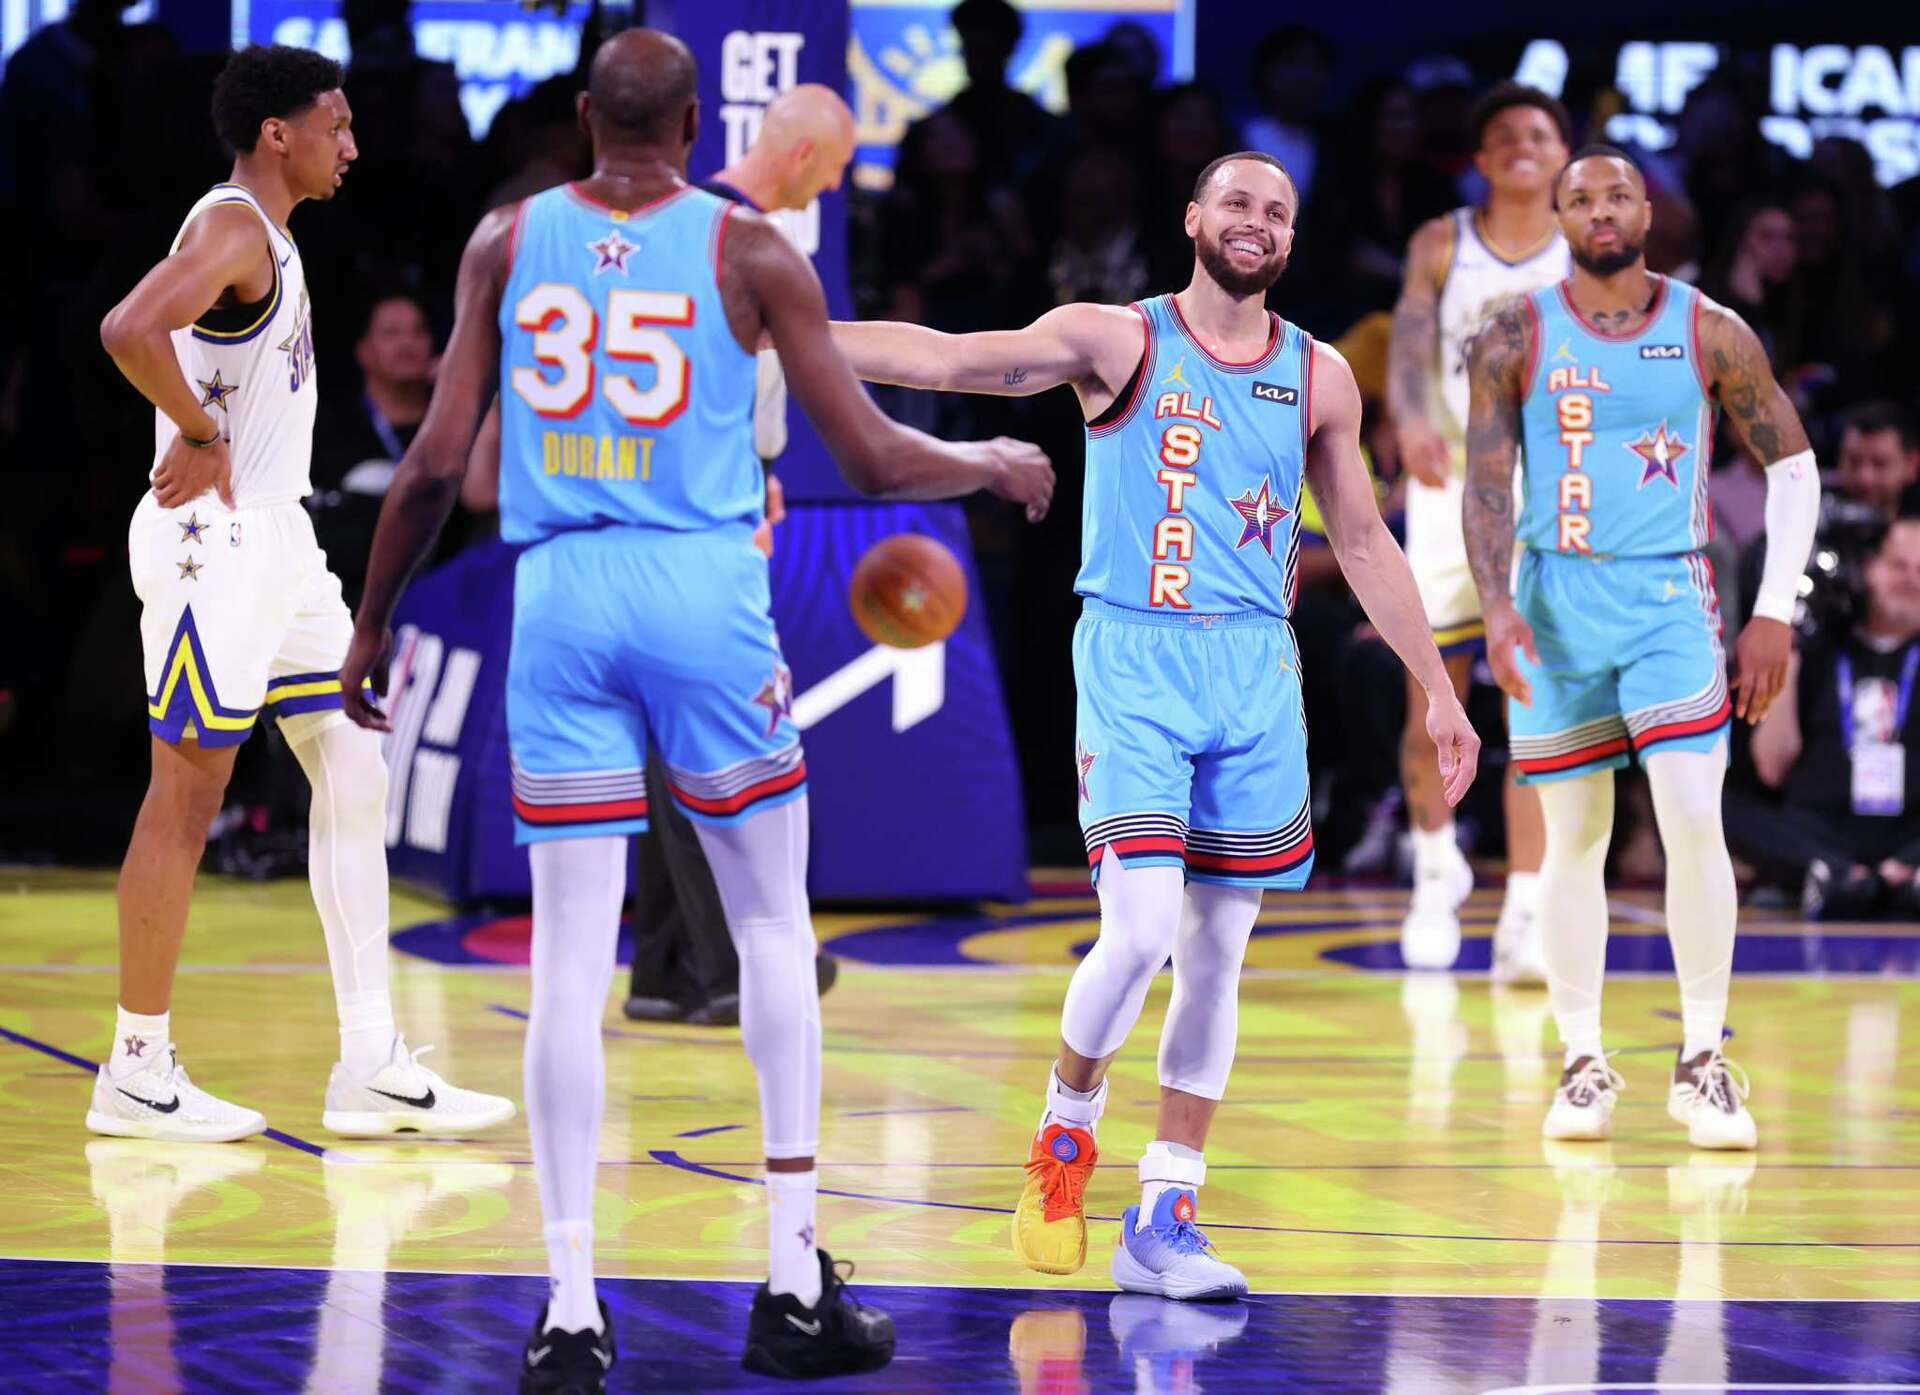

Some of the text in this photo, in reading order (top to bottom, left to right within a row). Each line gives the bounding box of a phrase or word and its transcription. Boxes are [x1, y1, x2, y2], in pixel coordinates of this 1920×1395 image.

[721, 30, 805, 103] GET
[511, 283, 695, 428] 35
[1548, 366, 1611, 393] ALL
[1156, 392, 1222, 430] ALL
[543, 431, 656, 481] DURANT
[1556, 394, 1594, 552] STAR
[1150, 424, 1202, 608] STAR
